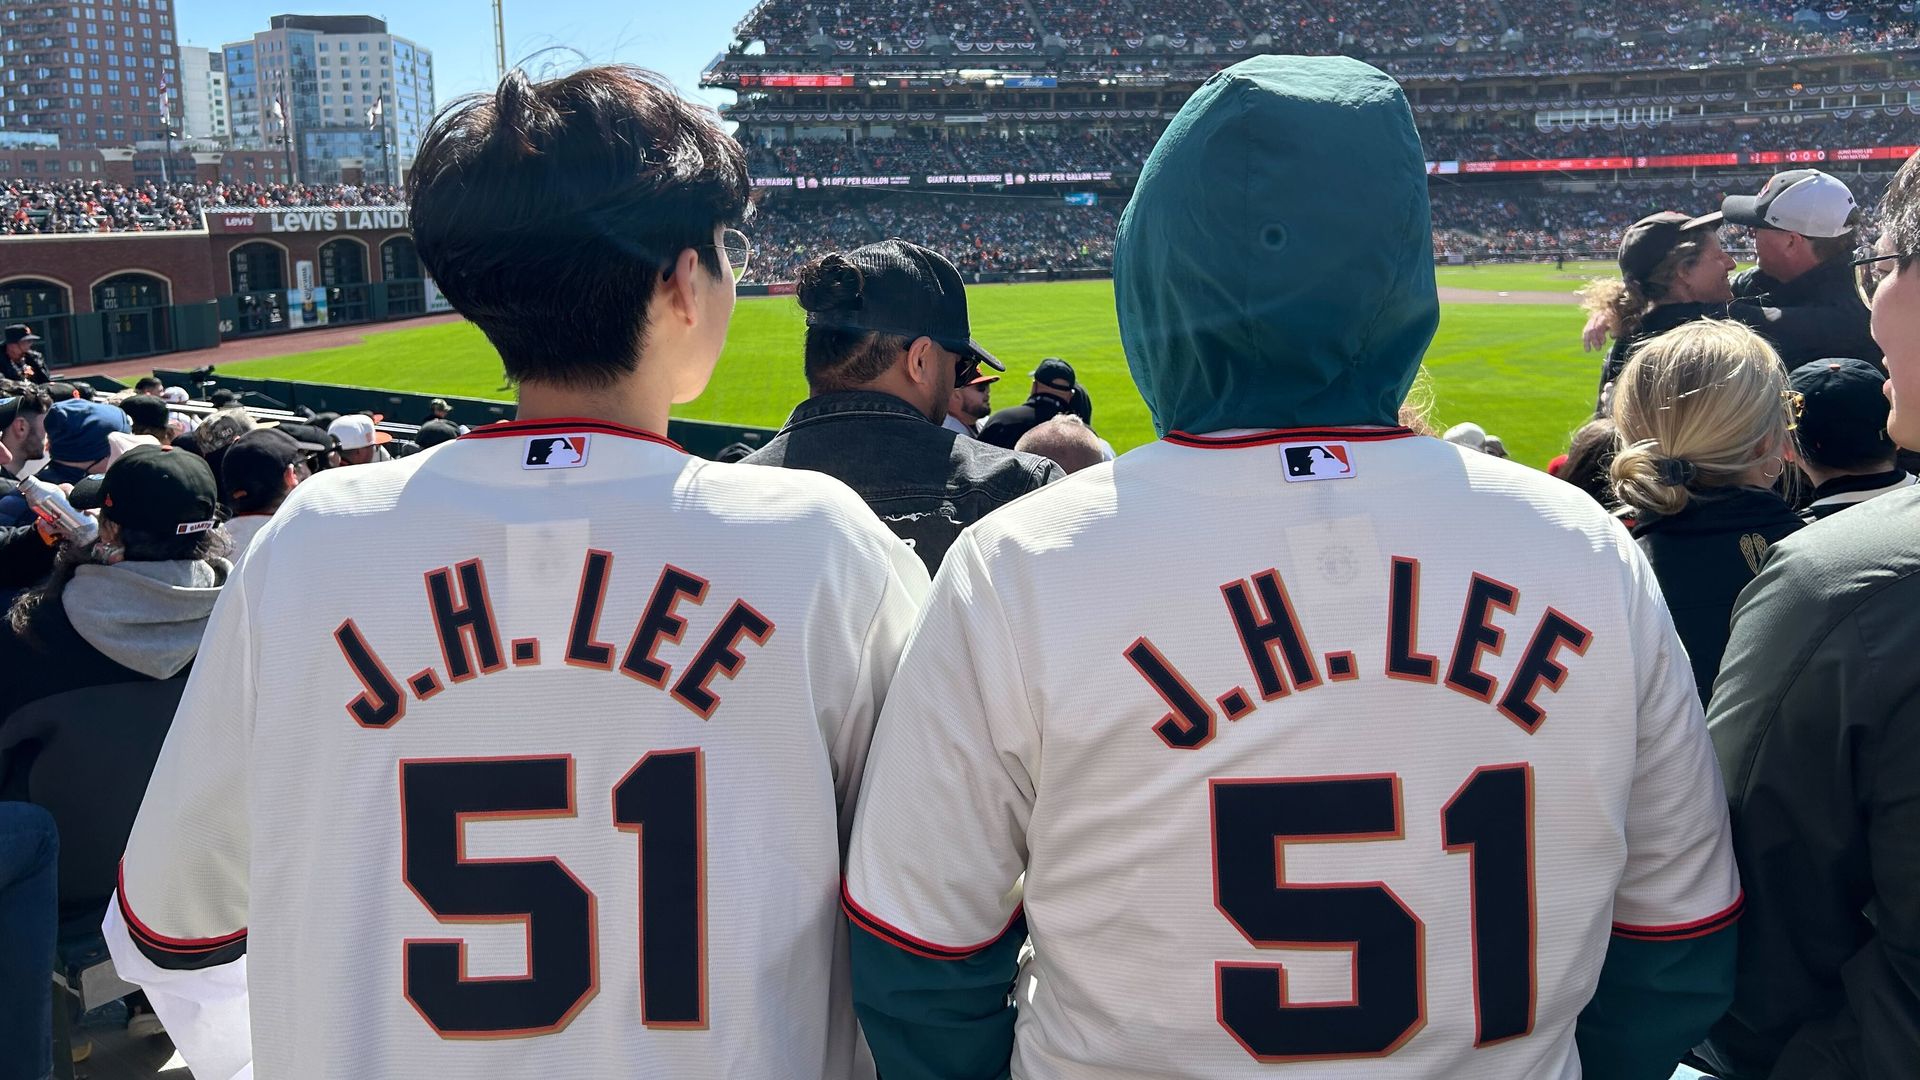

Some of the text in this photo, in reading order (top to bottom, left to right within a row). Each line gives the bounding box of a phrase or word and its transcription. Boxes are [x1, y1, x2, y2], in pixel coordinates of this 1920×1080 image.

[756, 177, 793, 187] REWARDS!
[831, 177, 846, 186] OFF
[847, 176, 861, 185] PER
[862, 176, 889, 186] GALLON
[927, 174, 1002, 184] GIANT FUEL REWARDS!
[1037, 173, 1050, 182] OFF
[1051, 173, 1066, 182] PER
[1066, 172, 1092, 181] GALLON
[333, 547, 776, 730] J.H. LEE
[1122, 555, 1594, 750] J.H. LEE
[399, 746, 710, 1041] 51
[1208, 761, 1538, 1064] 51
